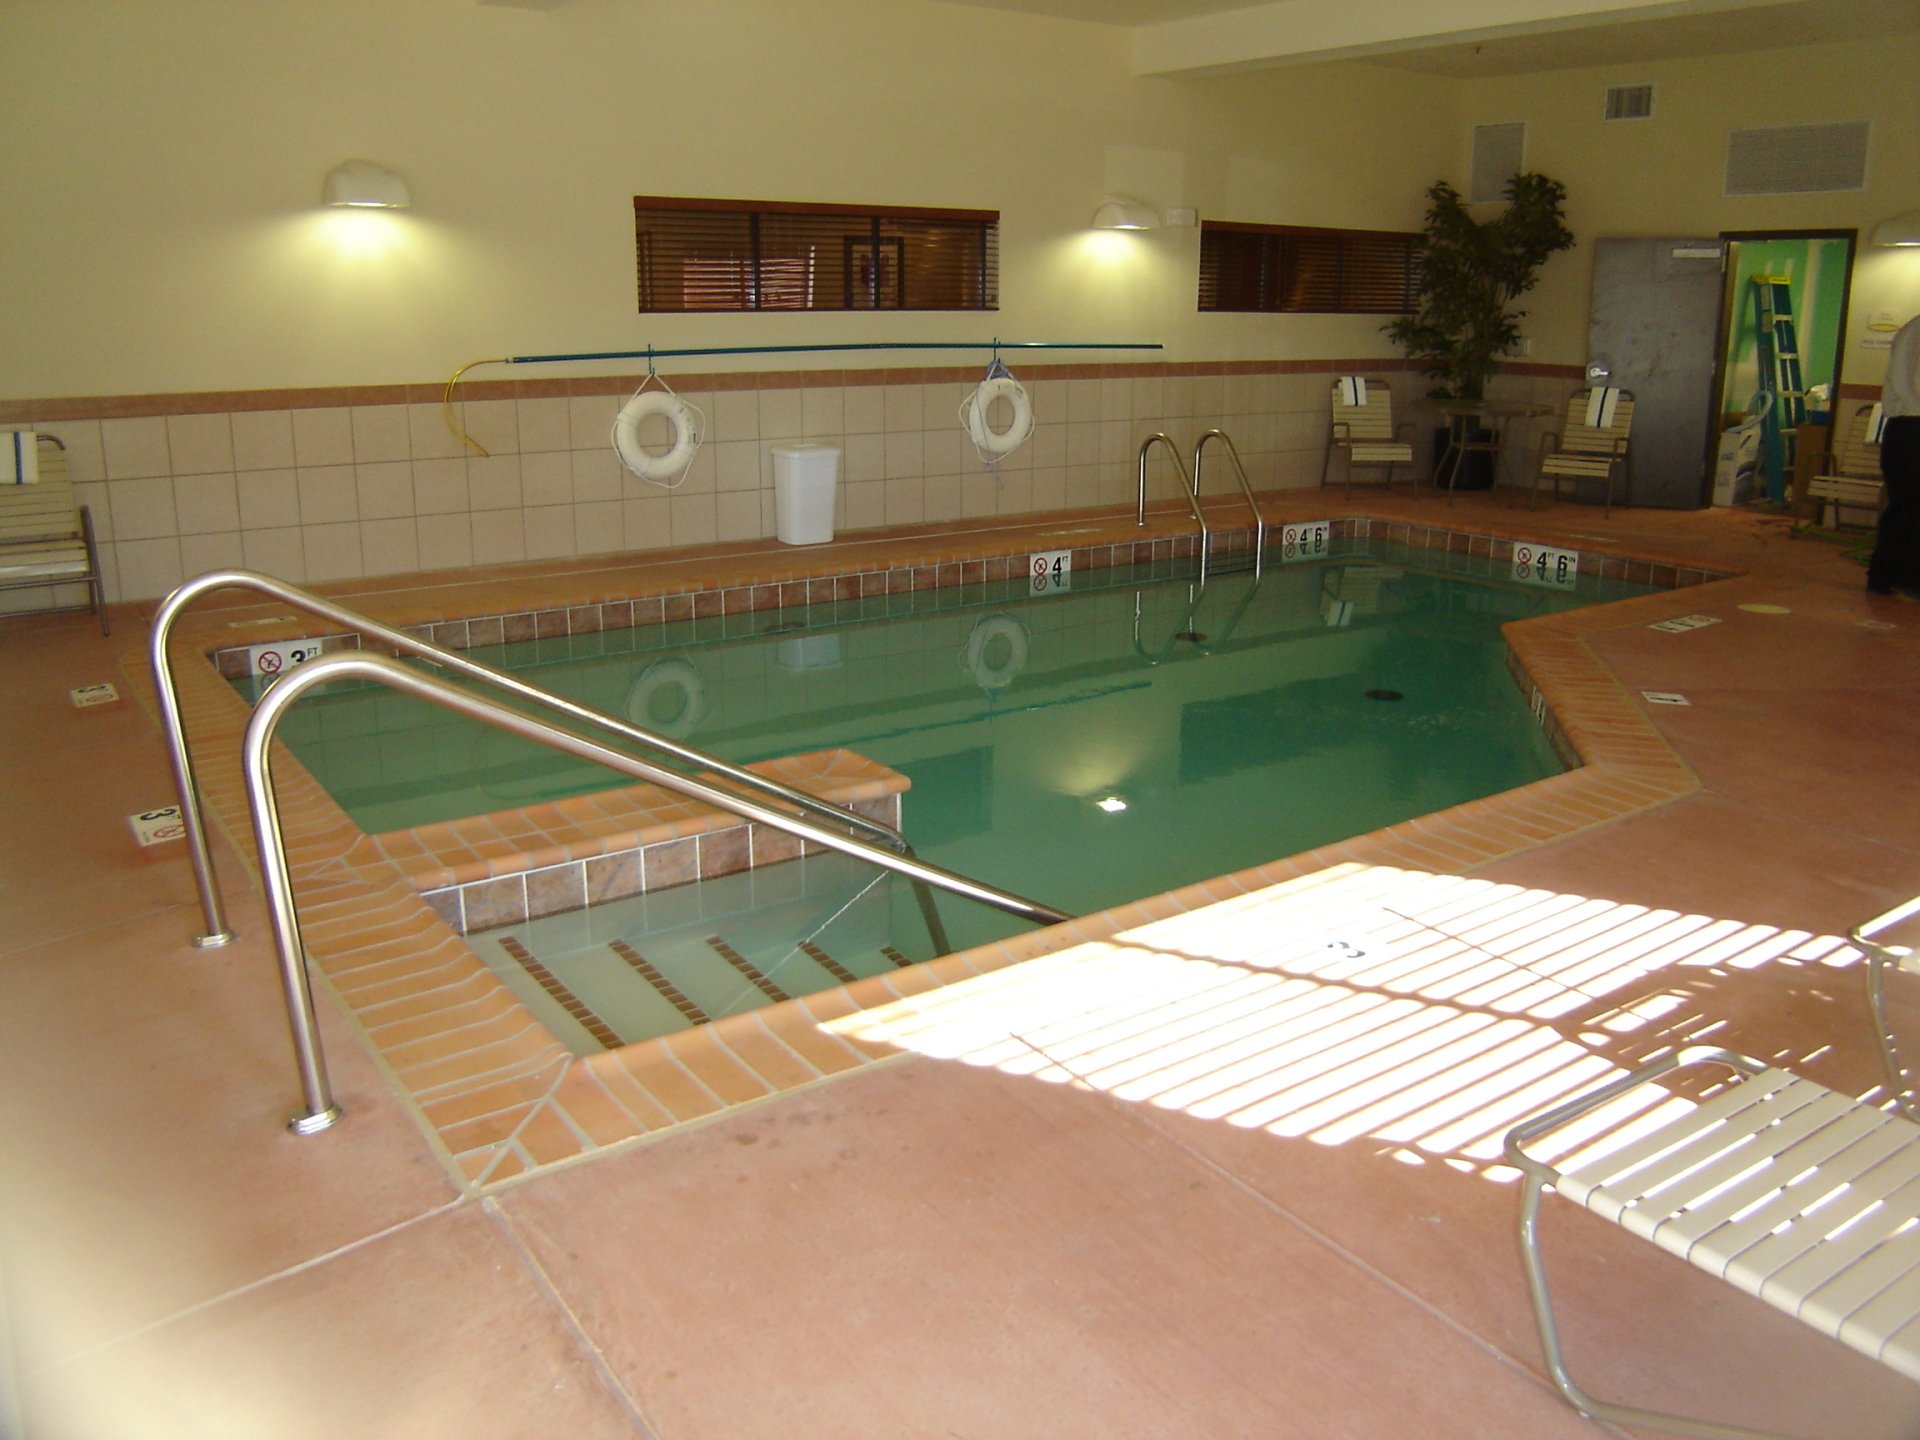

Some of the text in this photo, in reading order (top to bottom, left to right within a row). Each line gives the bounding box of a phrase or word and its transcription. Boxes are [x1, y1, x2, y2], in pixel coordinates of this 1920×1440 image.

[1300, 528, 1307, 542] 4
[1315, 526, 1322, 542] 6
[1052, 556, 1062, 574] 4
[1537, 551, 1547, 568] 4
[1558, 555, 1568, 571] 6
[308, 647, 318, 657] FT
[139, 808, 177, 821] 3
